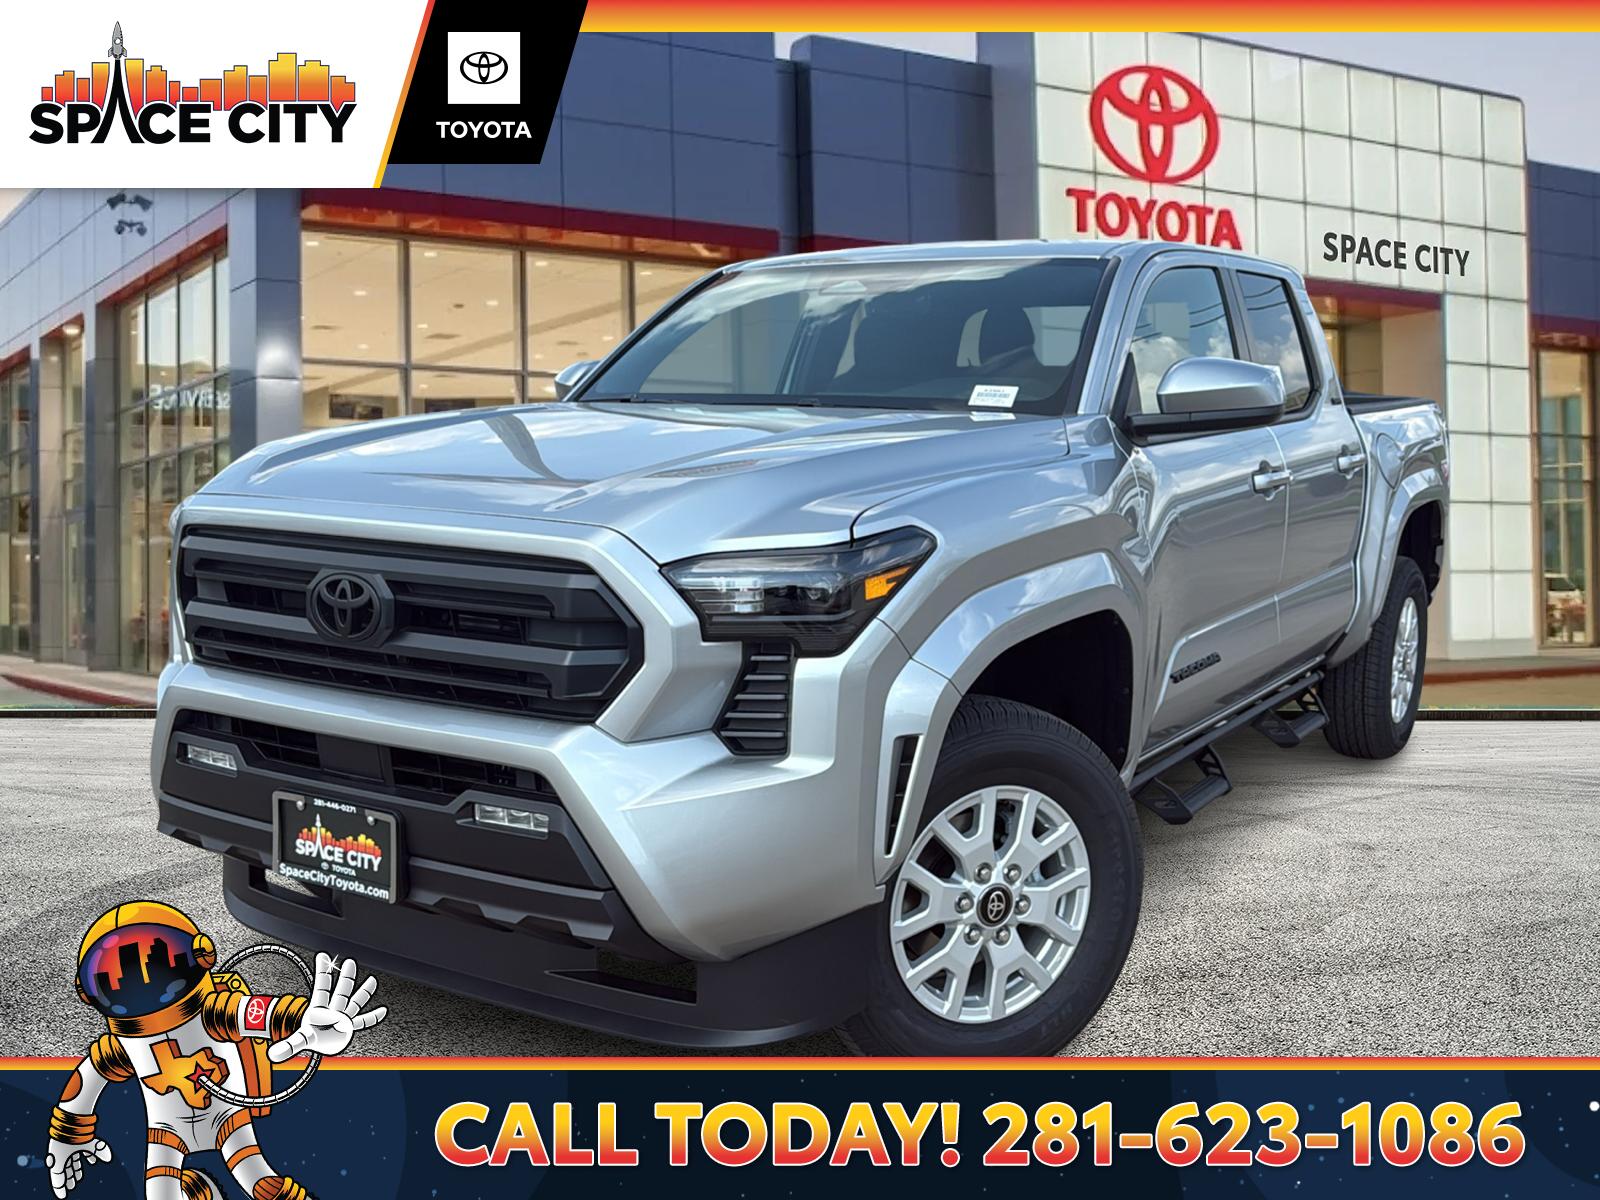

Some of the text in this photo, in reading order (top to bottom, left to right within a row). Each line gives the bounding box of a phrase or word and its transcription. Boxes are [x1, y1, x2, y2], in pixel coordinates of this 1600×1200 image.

[1066, 187, 1242, 250] TOYOTA
[1323, 232, 1470, 277] SPACE CITY
[295, 828, 382, 872] SPACE CITY
[331, 864, 357, 877] TOYOTA
[279, 862, 390, 900] SpaceCityToyota.com
